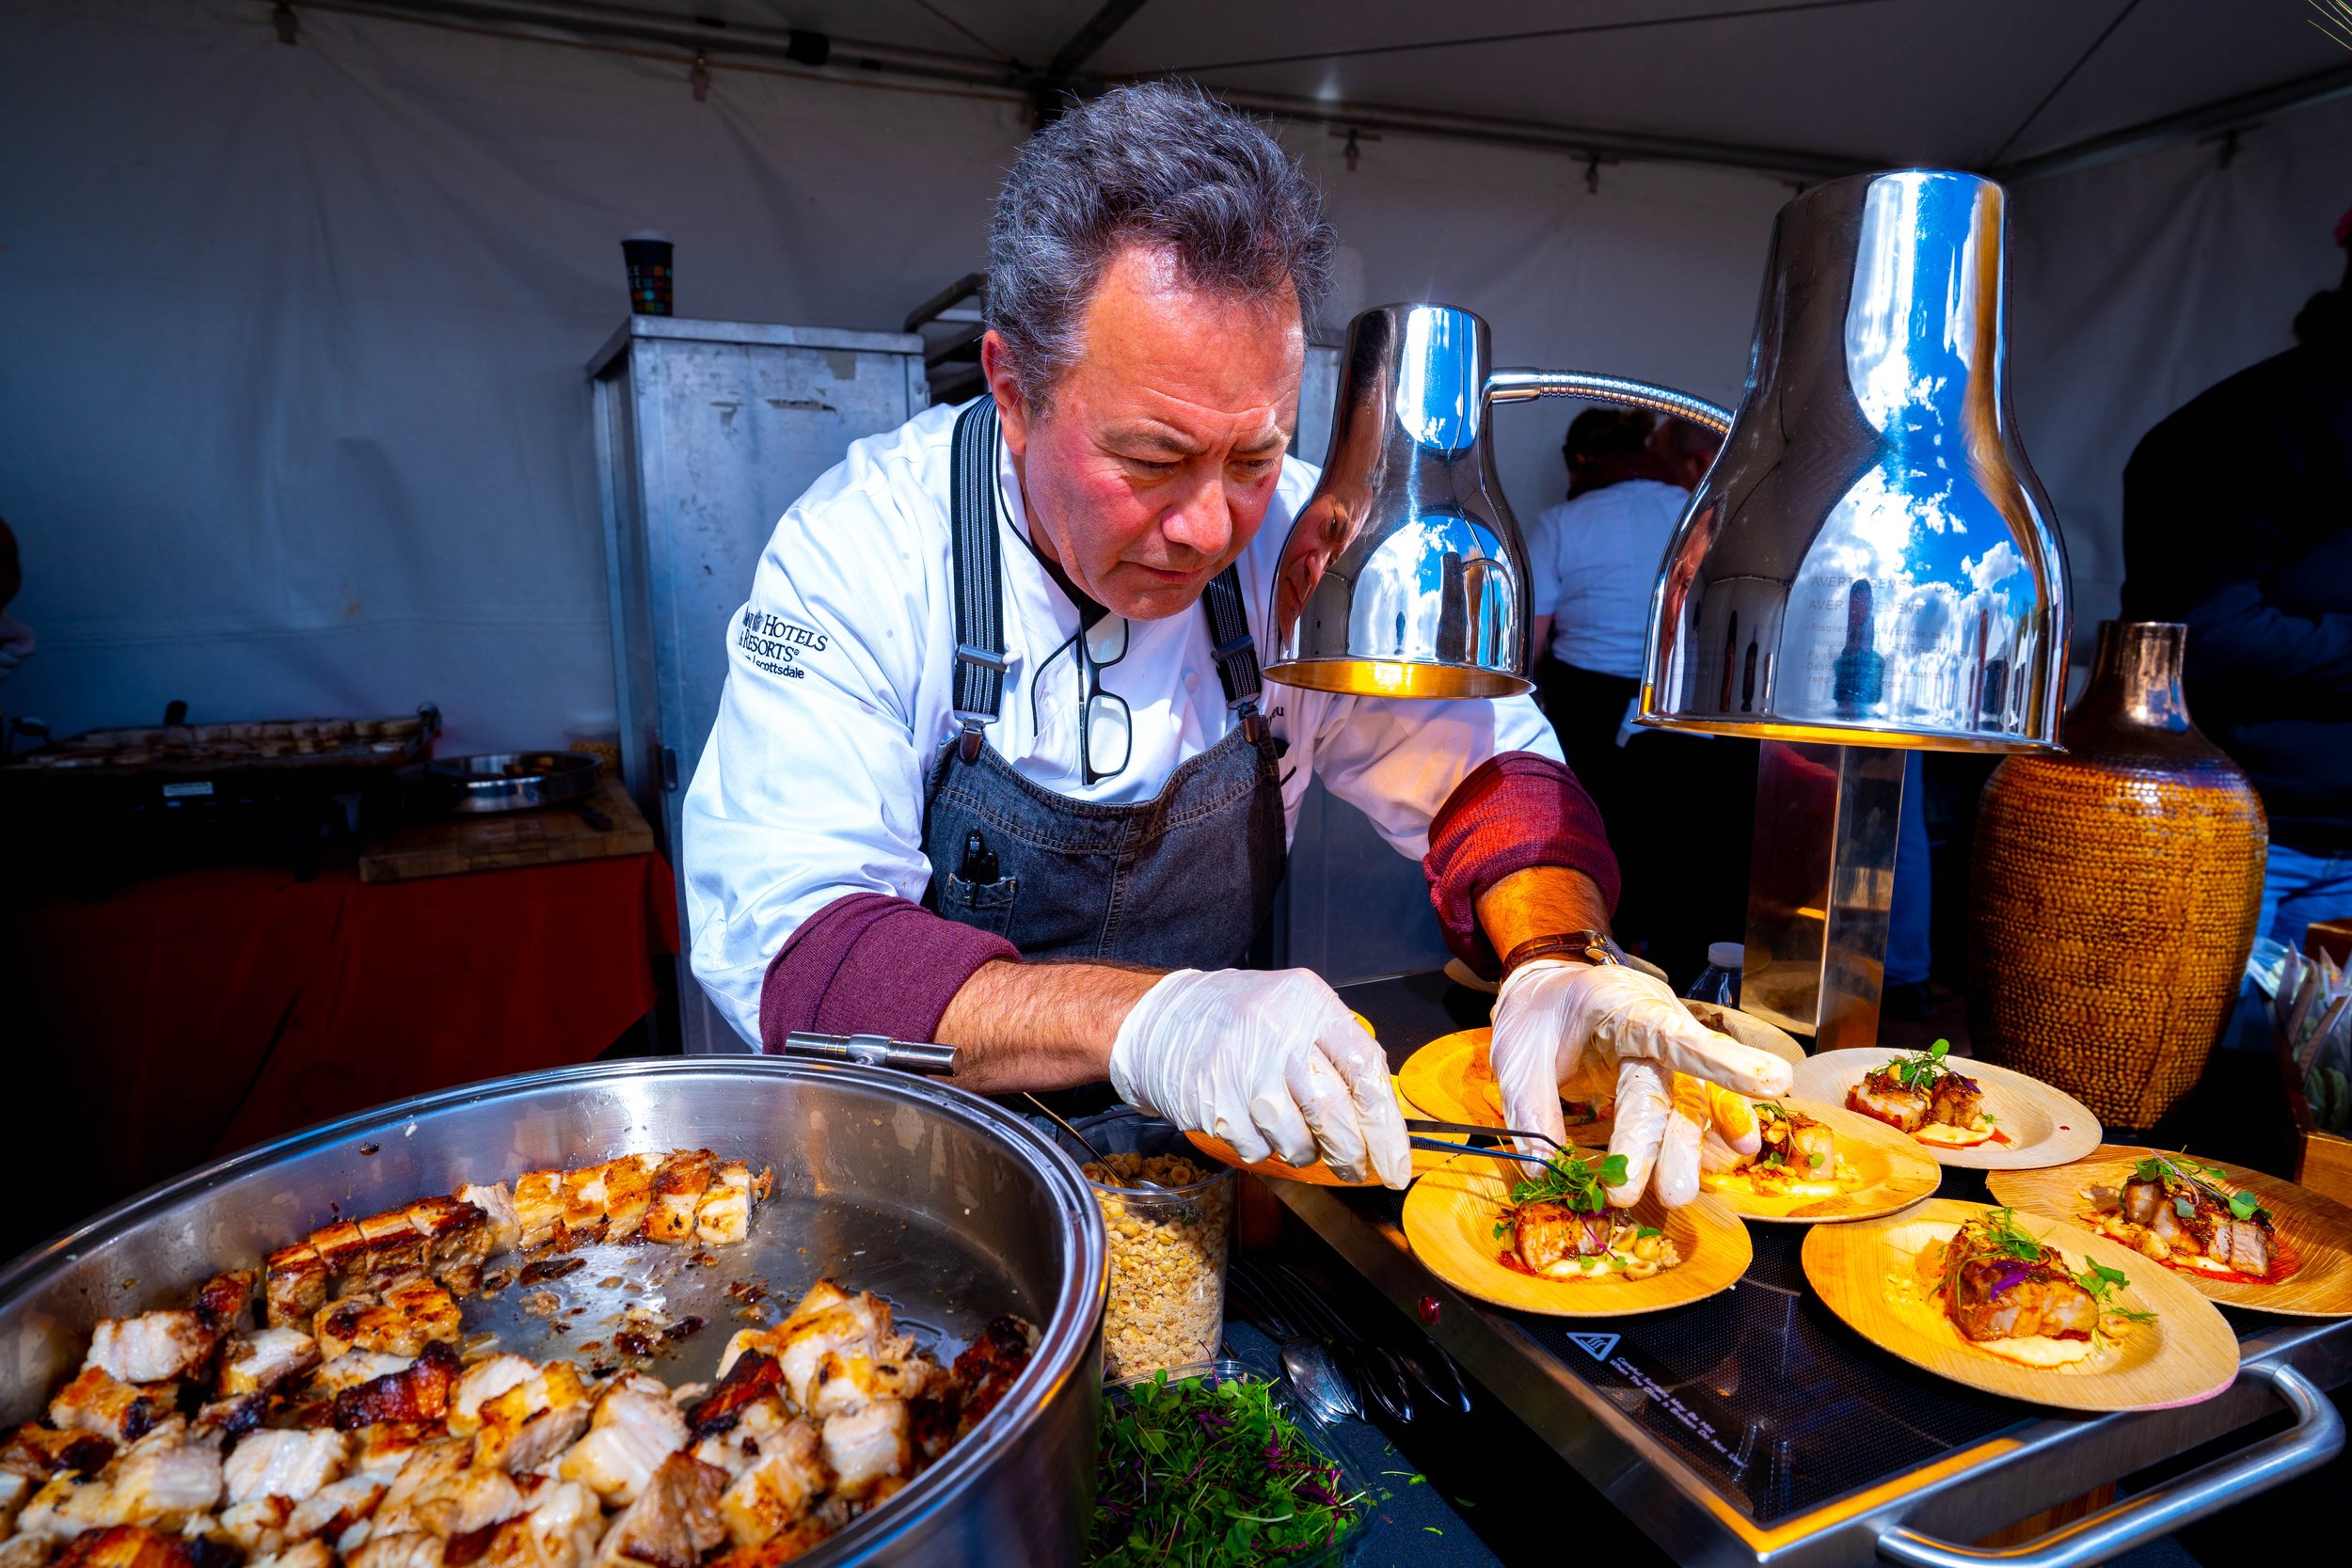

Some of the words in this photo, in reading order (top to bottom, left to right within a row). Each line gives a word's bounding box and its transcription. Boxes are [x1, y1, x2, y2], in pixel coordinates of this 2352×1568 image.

[762, 614, 828, 651] HOTELS
[755, 660, 805, 679] scottsdale
[1610, 1359, 1629, 1376] When
[1629, 1374, 1644, 1386] The
[1670, 1407, 1697, 1430] Broken
[1697, 1429, 1710, 1440] Do
[1710, 1439, 1728, 1453] Not
[1643, 1377, 1670, 1399] Surface
[1670, 1398, 1688, 1412] May
[1687, 1412, 1699, 1421] Be
[1700, 1421, 1716, 1434] Hot
